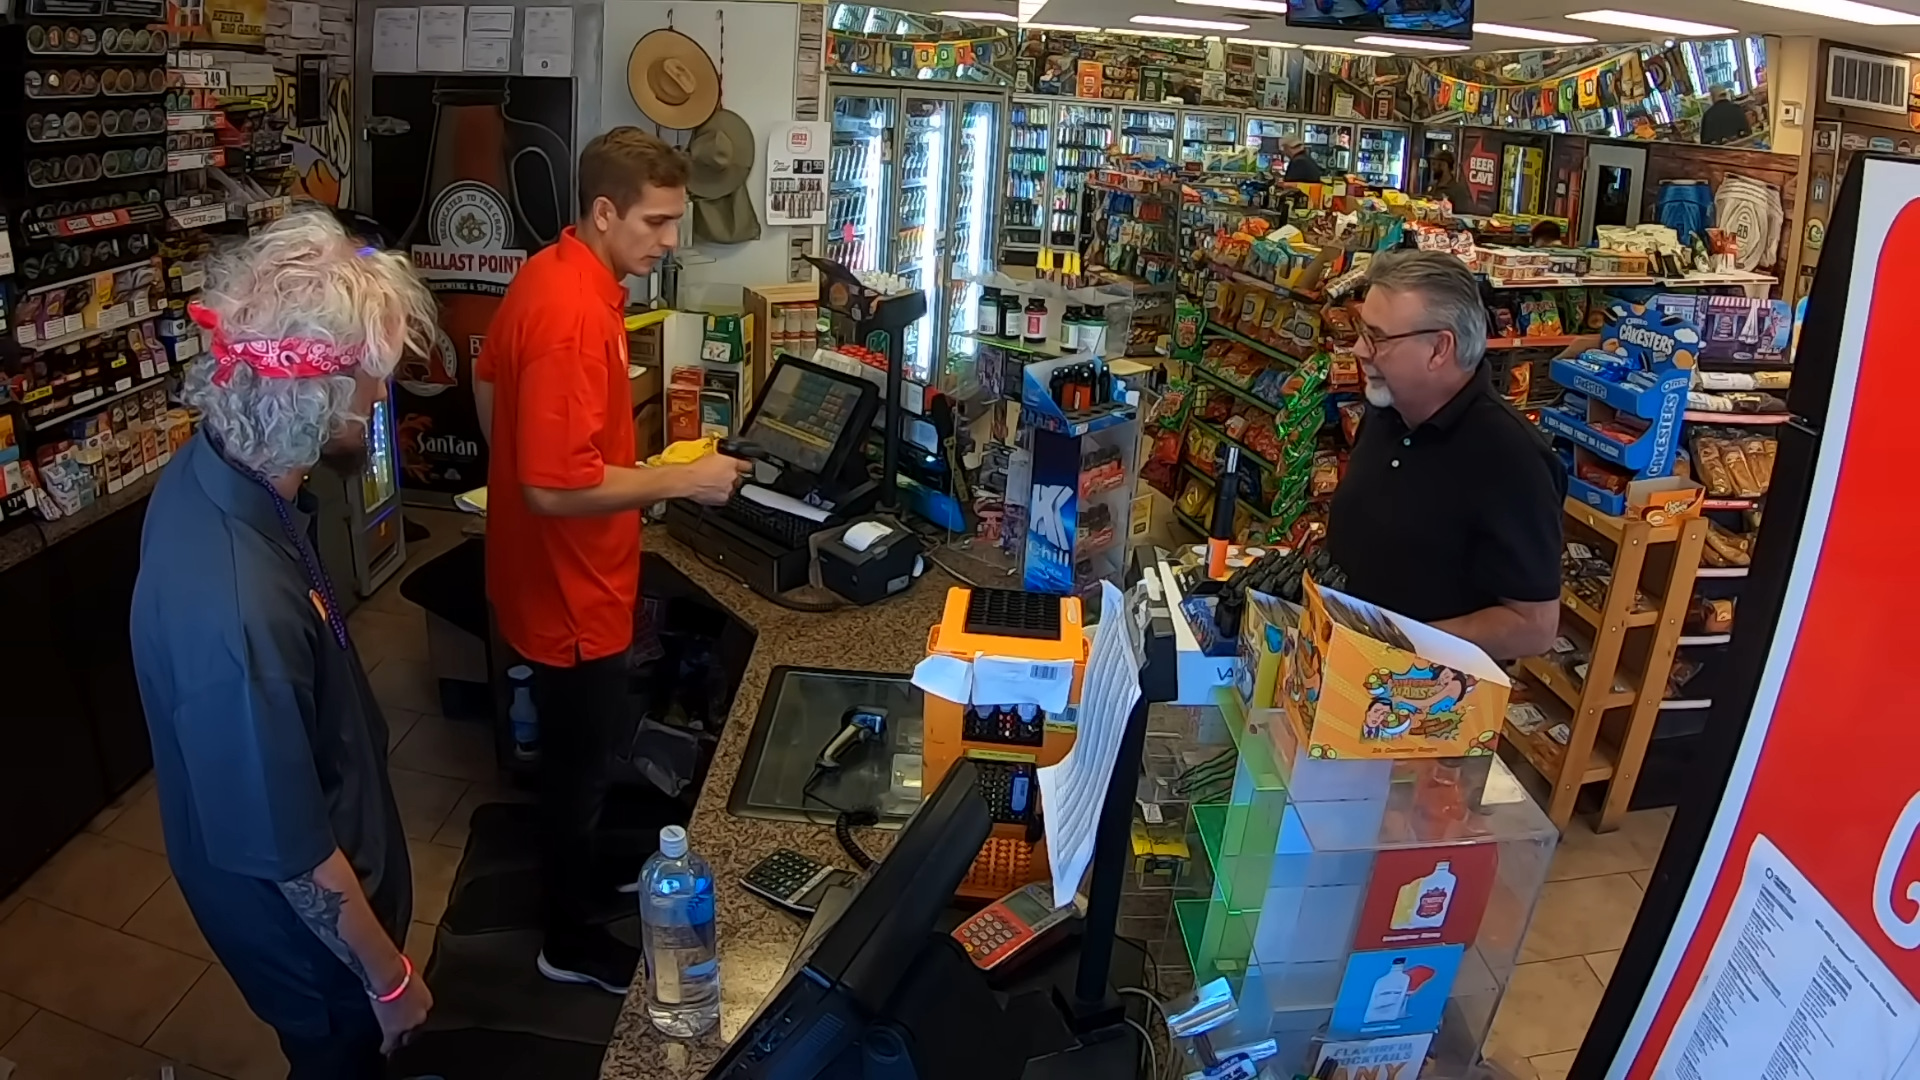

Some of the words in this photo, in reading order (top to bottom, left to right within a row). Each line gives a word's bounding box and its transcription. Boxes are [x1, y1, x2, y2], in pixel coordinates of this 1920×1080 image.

[1470, 157, 1494, 172] BEER
[1469, 170, 1494, 186] CAVE
[440, 195, 463, 240] DEDICATED
[466, 194, 477, 202] TO
[479, 196, 495, 213] THE
[492, 212, 503, 243] CRAFT
[414, 250, 475, 272] BALLAST
[478, 254, 523, 274] POINT
[1619, 324, 1675, 356] CAKESTERS
[416, 431, 478, 457] SanTan
[1646, 393, 1679, 477] CAKESTERS
[1028, 540, 1070, 568] Chill
[1333, 1042, 1413, 1057] FLAVORFUL
